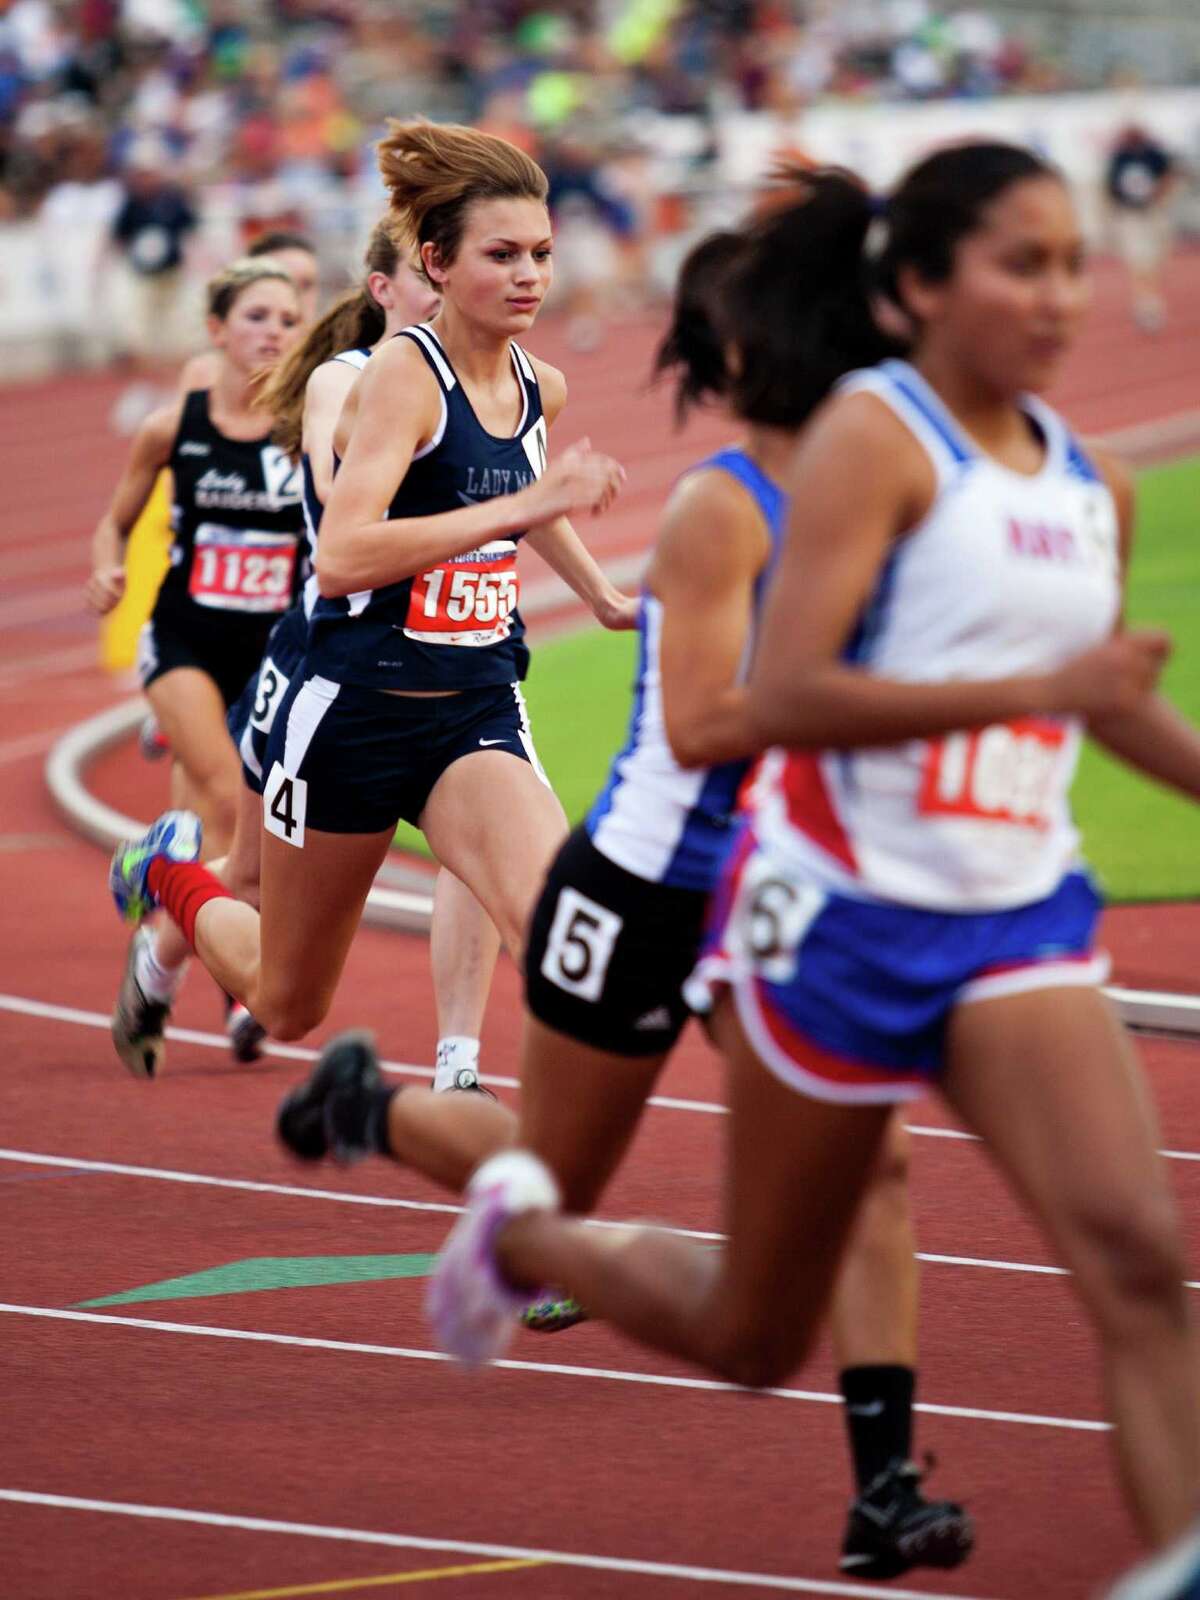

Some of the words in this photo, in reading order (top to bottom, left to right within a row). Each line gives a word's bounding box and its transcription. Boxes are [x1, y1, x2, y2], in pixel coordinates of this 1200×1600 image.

[465, 467, 511, 496] LADY
[200, 547, 290, 595] 1123
[422, 568, 517, 622] 1555
[253, 669, 278, 722] 3
[270, 777, 297, 839] 4
[559, 907, 600, 983] 5
[748, 878, 797, 959] 6
